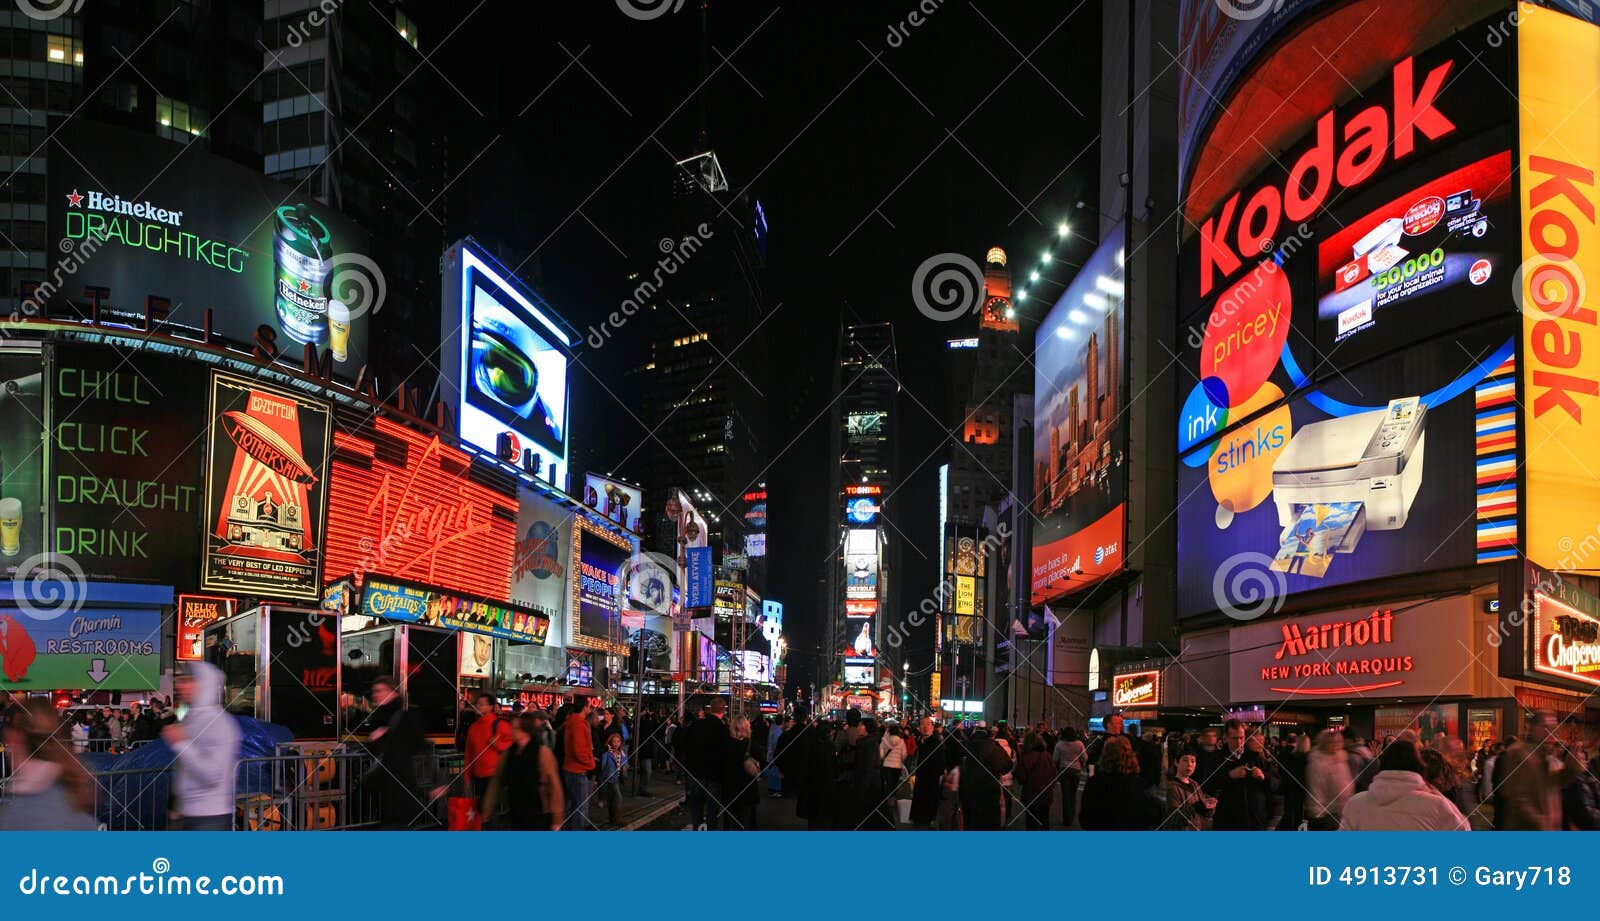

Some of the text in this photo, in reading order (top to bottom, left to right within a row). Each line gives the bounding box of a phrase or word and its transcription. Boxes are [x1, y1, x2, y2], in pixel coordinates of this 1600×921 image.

[1200, 56, 1456, 298] Kodak
[88, 190, 182, 226] Heineken
[1371, 247, 1444, 290] $50,000
[1377, 265, 1445, 301] for your local animal
[281, 284, 326, 309] Heineken
[1377, 274, 1444, 307] rescue organization
[1529, 155, 1599, 425] Kodak
[1341, 309, 1367, 327] Kodak
[1213, 302, 1282, 372] pricey
[58, 368, 150, 405] CHILL
[57, 422, 148, 457] CLICK
[1187, 404, 1218, 442] ink
[231, 424, 304, 481] MOTHERSHIP
[1216, 424, 1285, 474] stinks
[57, 475, 196, 513] DRAUGHT
[846, 486, 881, 494] TOSHIBA
[367, 434, 491, 583] Virgin
[56, 527, 149, 559] DRINK
[214, 557, 226, 566] THE
[228, 559, 245, 567] VERY
[246, 560, 262, 569] BEST
[262, 562, 271, 570] OF
[272, 563, 284, 571] LED
[284, 564, 313, 576] ZEPPELIN
[581, 561, 607, 582] WAKE
[185, 601, 217, 611] NELLY
[717, 587, 733, 595] UFC
[69, 614, 121, 638] Charmin
[1274, 608, 1394, 660] Marriott
[47, 639, 153, 656] RESTROOMS
[1261, 656, 1413, 681] NEW YORK MARQUIS
